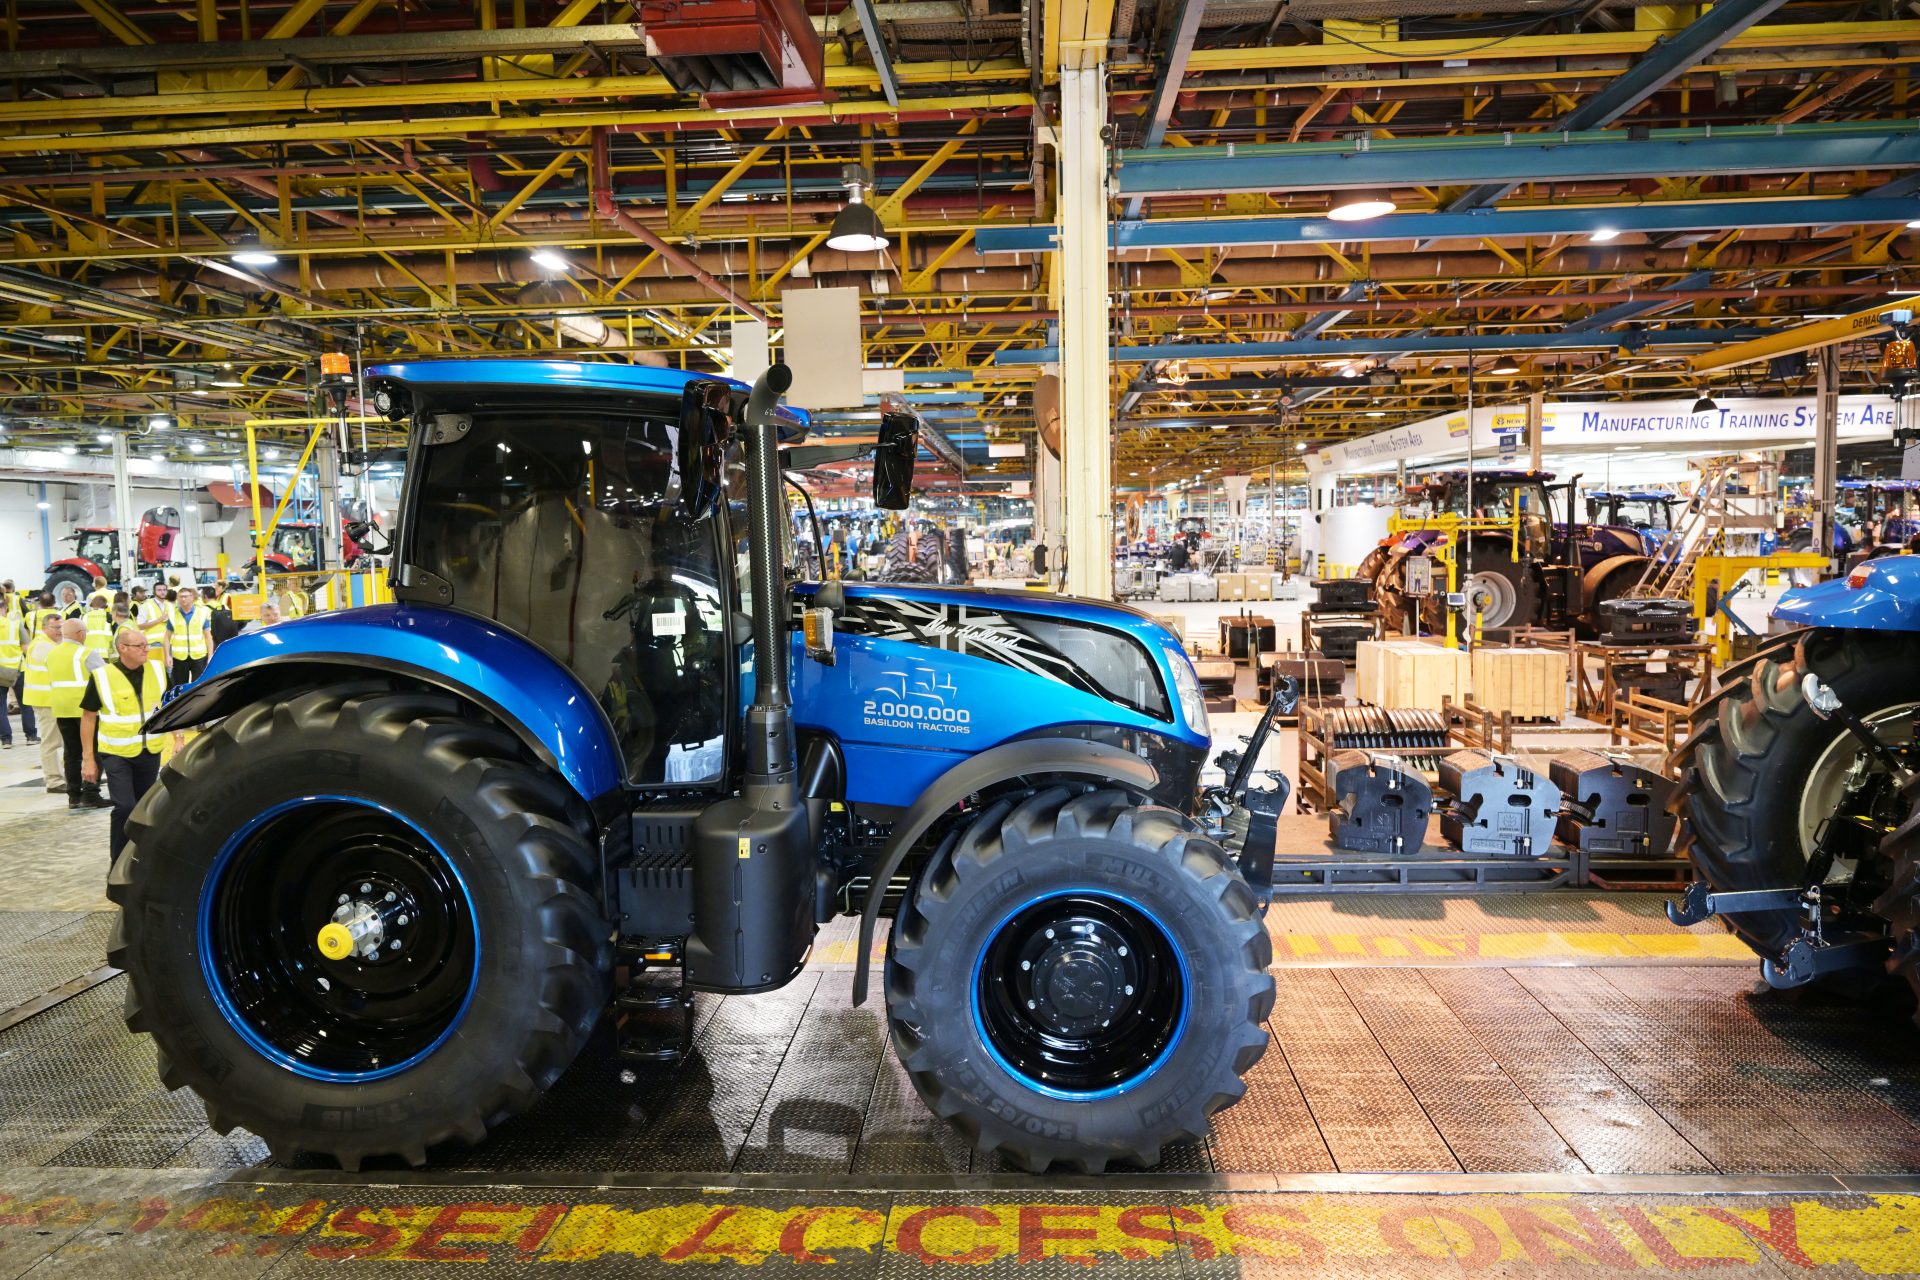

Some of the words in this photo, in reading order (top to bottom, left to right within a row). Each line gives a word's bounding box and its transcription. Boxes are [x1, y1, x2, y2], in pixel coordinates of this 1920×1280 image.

[1582, 411, 1710, 432] MANUFACTURING
[1718, 408, 1789, 429] TRAINING
[1793, 406, 1855, 427] SYEM
[1859, 404, 1902, 425] ARE
[922, 617, 956, 635] New
[954, 624, 1023, 649] Holland
[863, 717, 914, 729] BASILDON
[917, 722, 970, 734] TRACTORS
